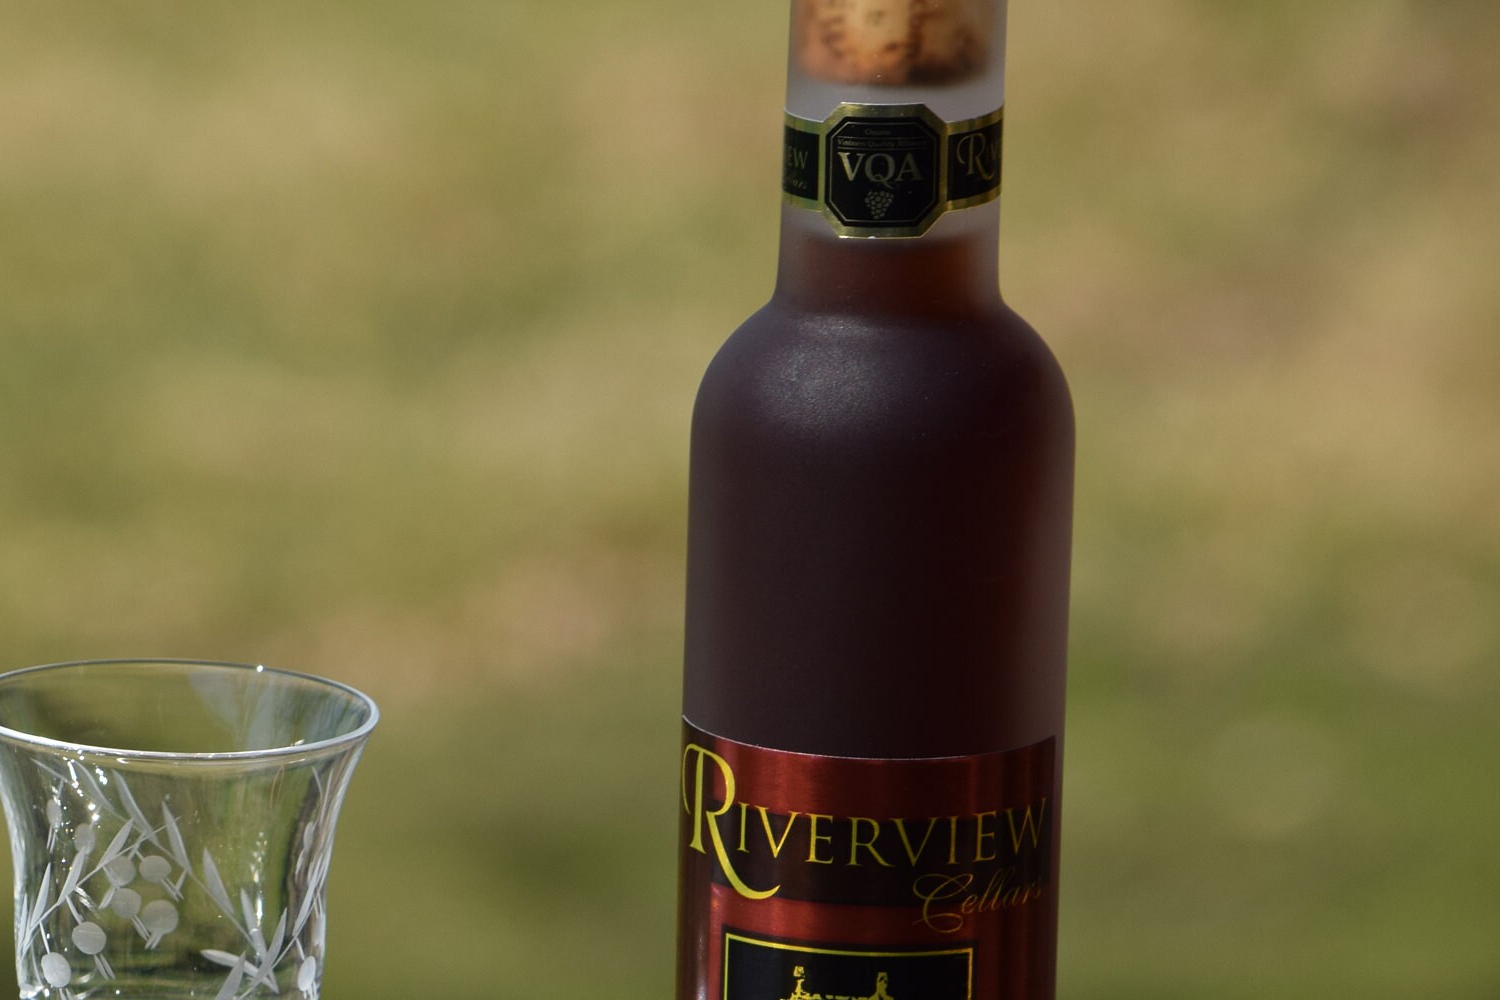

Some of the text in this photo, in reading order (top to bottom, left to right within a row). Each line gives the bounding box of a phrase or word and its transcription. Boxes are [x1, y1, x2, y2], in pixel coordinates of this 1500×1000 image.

[837, 151, 924, 189] VQA
[682, 743, 1047, 900] RIVERVIEW
[911, 865, 1043, 934] Cellars
